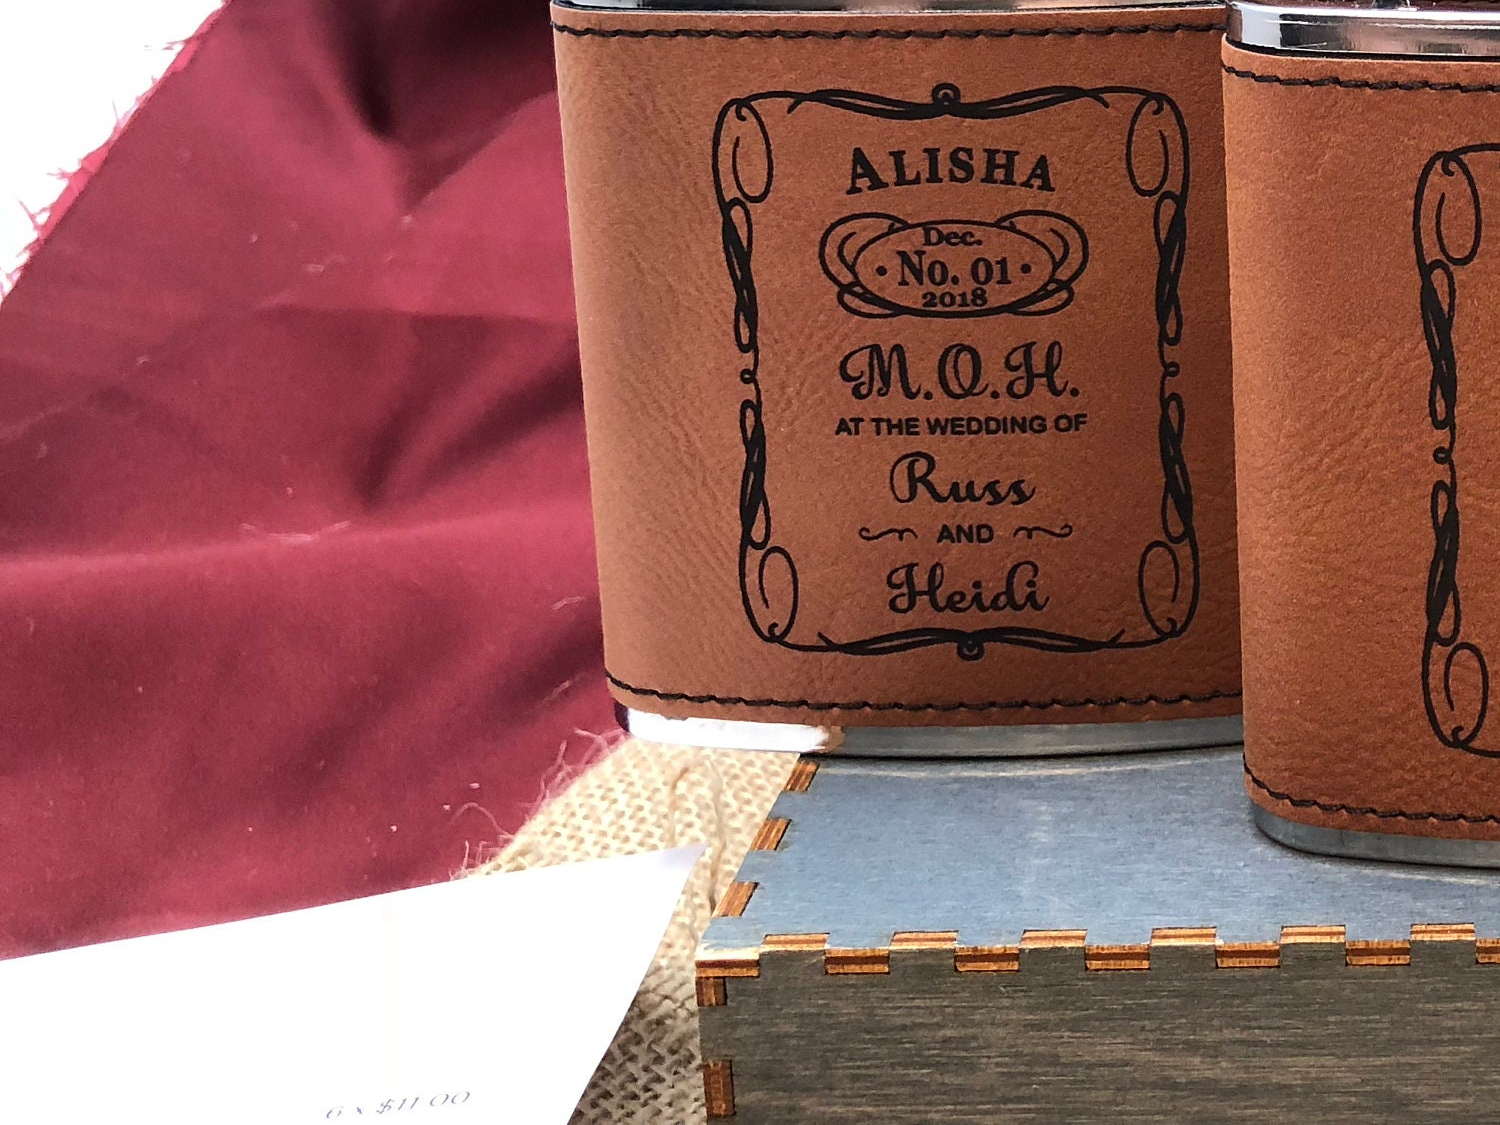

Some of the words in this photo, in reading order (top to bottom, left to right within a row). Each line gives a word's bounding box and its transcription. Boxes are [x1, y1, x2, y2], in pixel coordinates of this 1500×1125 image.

[846, 147, 1055, 195] ALISHA
[922, 227, 983, 246] Dec.
[897, 251, 959, 286] No.
[971, 257, 1011, 286] 01
[922, 288, 988, 308] 2018
[839, 340, 1080, 400] M.O.H.
[835, 417, 865, 435] AT
[873, 417, 920, 436] THE
[926, 416, 1047, 435] WEDDING
[1054, 414, 1087, 432] OF
[890, 451, 1036, 506] Russ
[937, 524, 994, 543] AND
[887, 561, 1050, 614] Heidi
[375, 1091, 471, 1115] $1100
